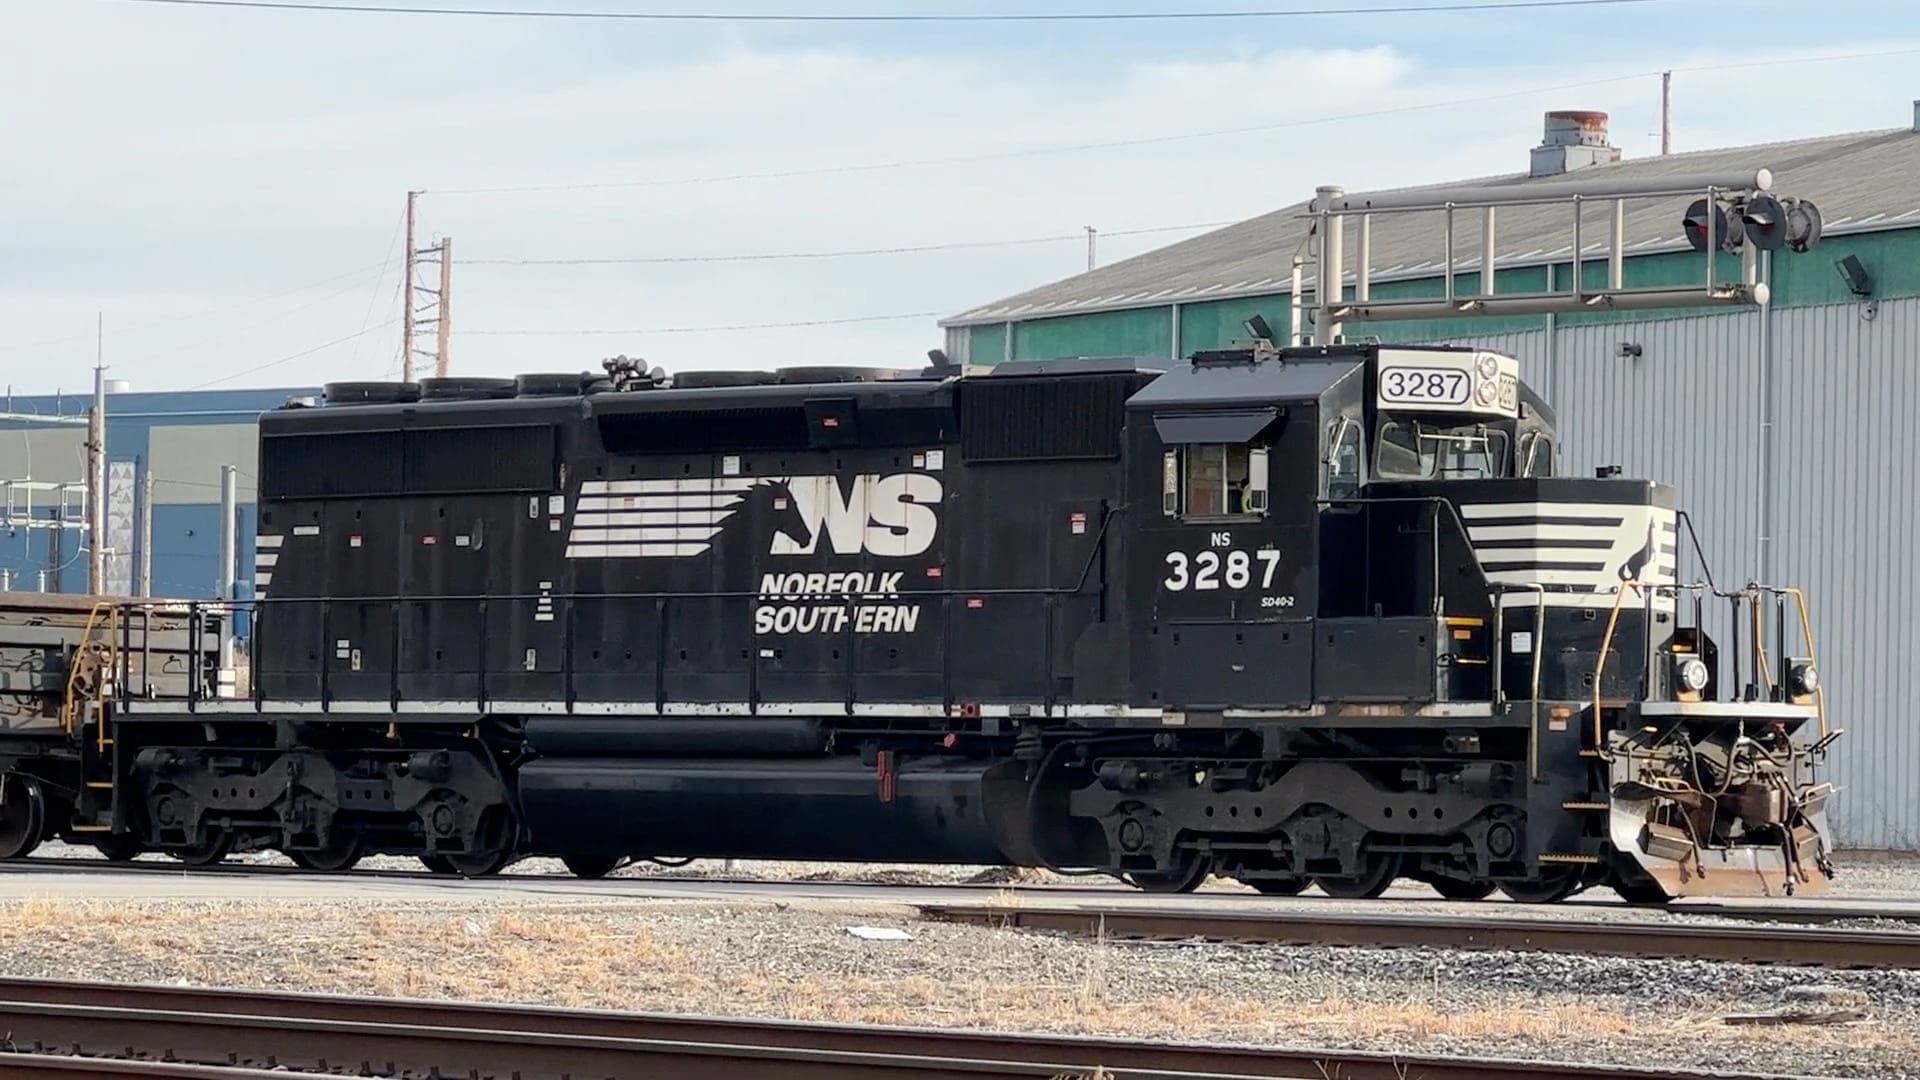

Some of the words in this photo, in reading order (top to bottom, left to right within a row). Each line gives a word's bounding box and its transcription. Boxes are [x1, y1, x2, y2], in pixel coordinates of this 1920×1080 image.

[1387, 372, 1463, 400] 3287
[769, 473, 944, 557] NS
[1210, 531, 1231, 547] NS
[1164, 550, 1281, 591] 3287
[758, 571, 904, 600] NORFOLK
[1260, 596, 1295, 608] SD40-2
[754, 604, 920, 634] SOUTHERN
